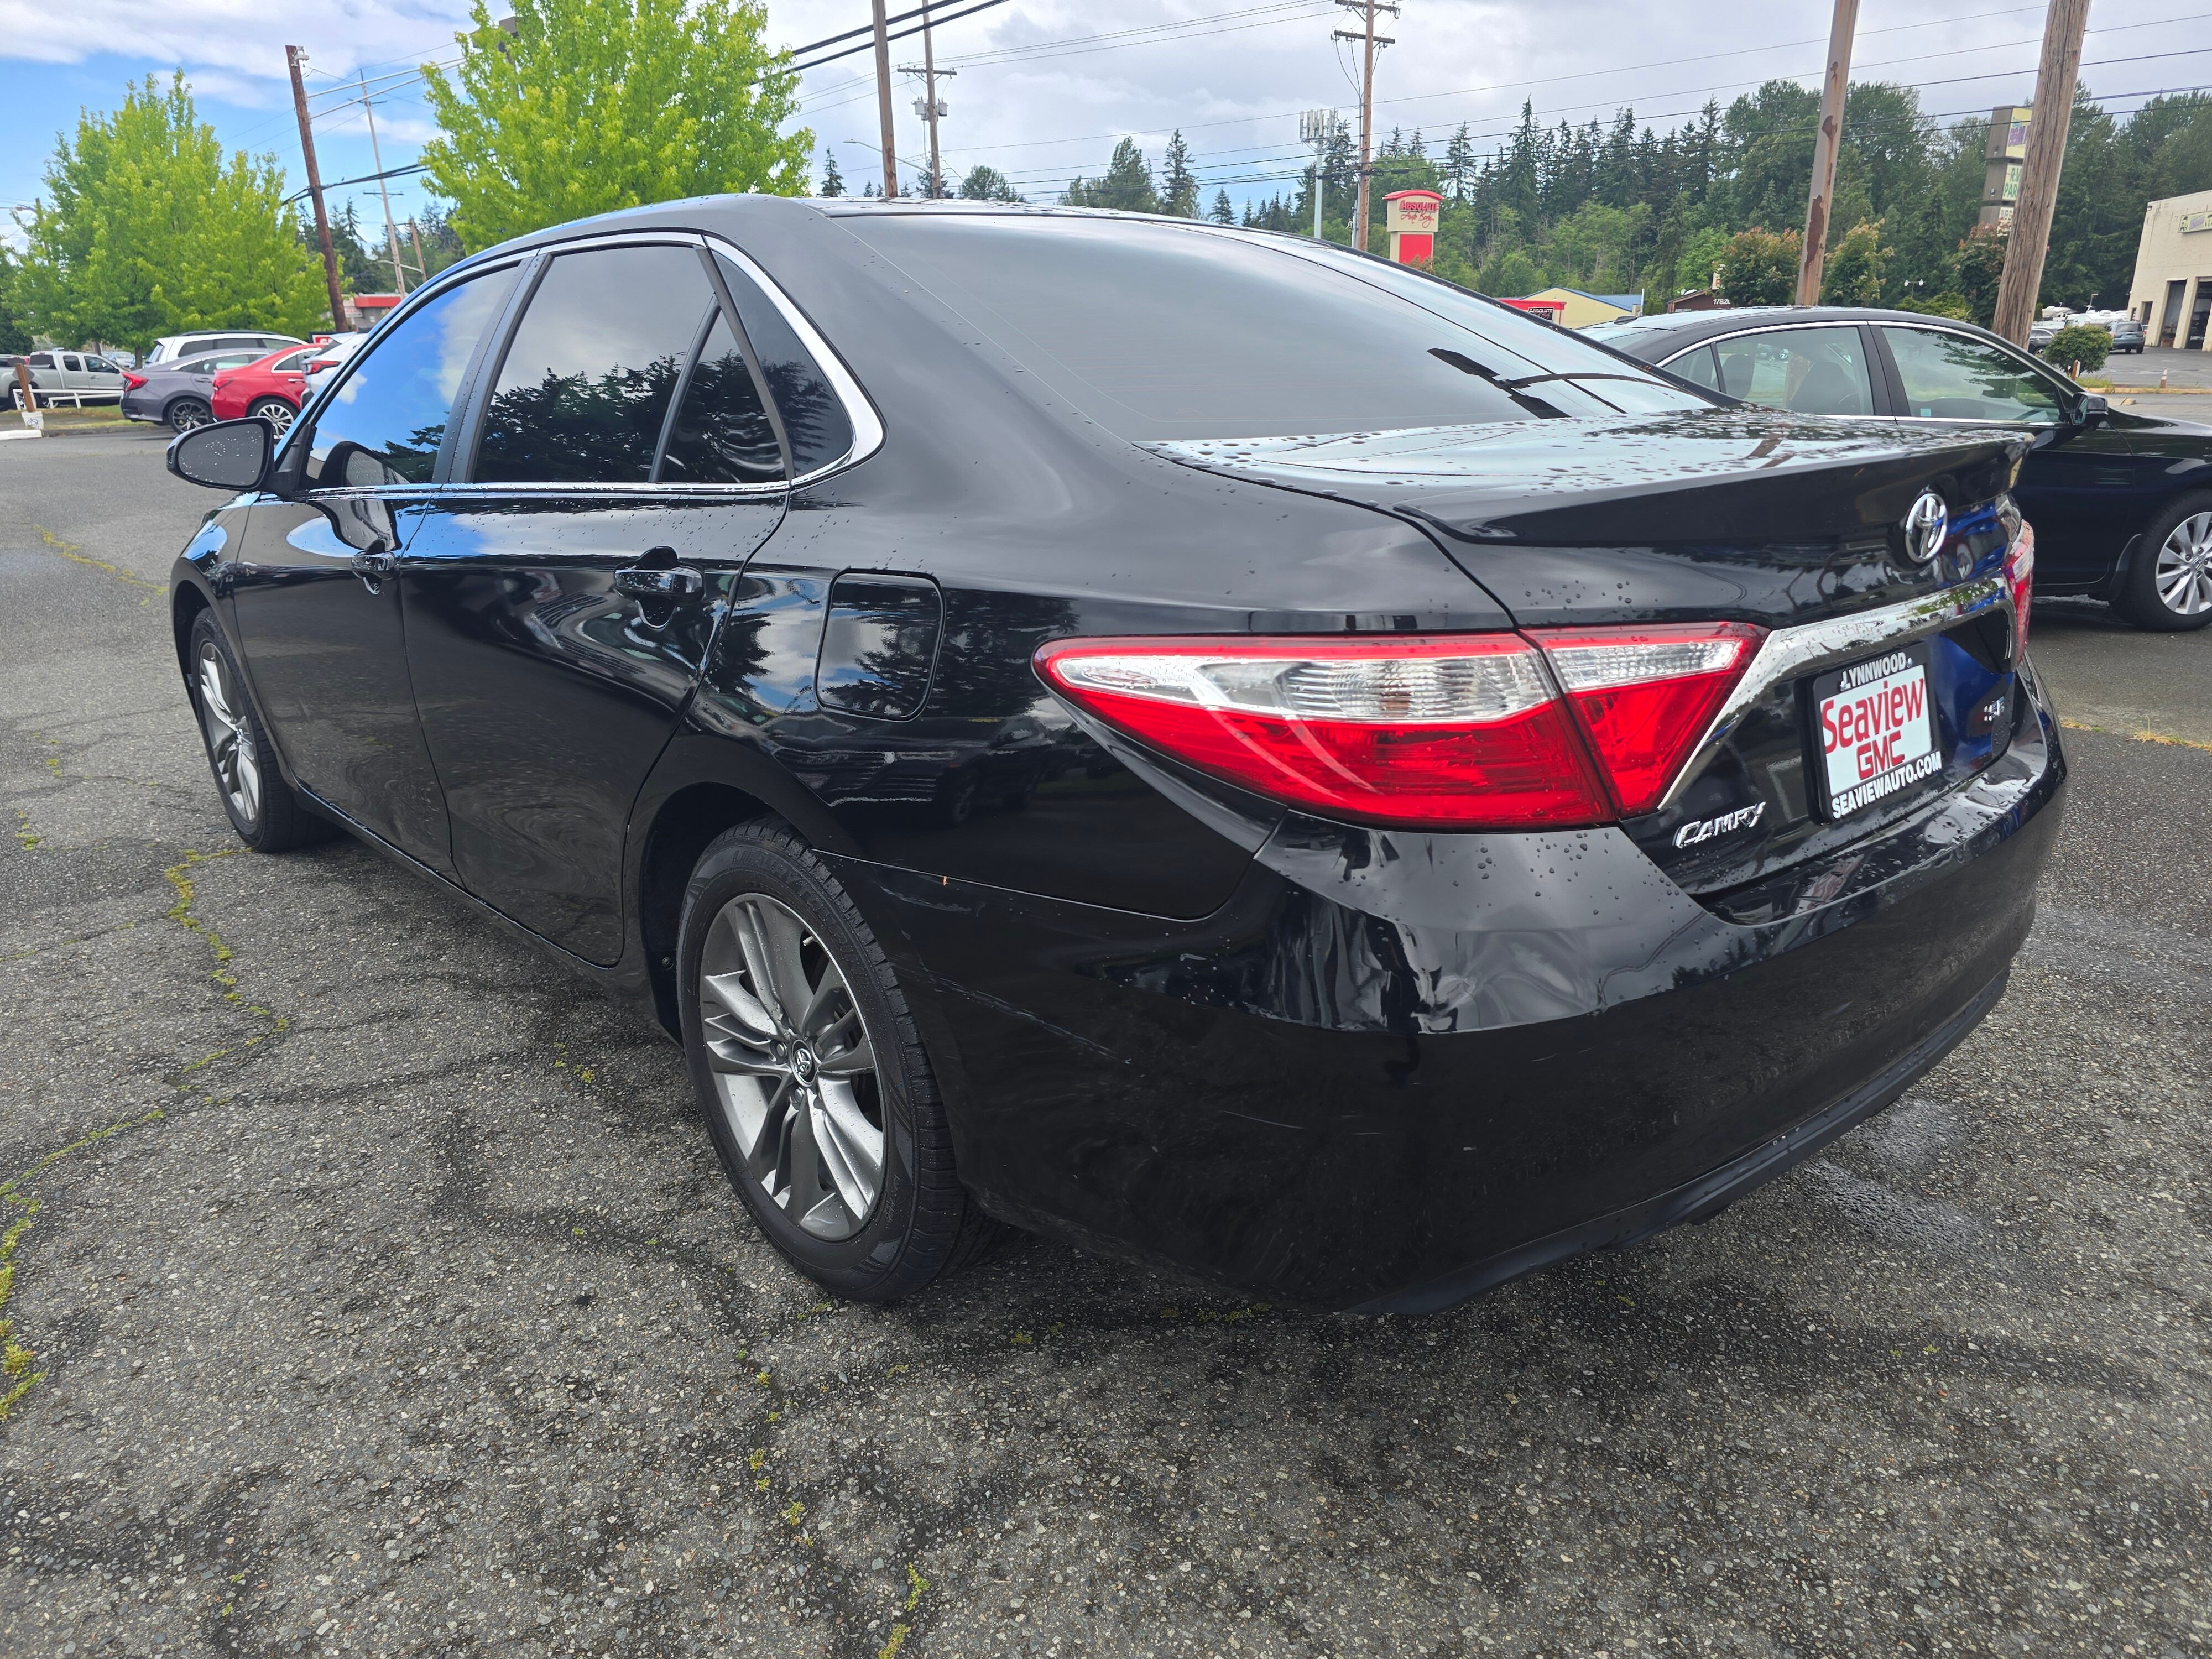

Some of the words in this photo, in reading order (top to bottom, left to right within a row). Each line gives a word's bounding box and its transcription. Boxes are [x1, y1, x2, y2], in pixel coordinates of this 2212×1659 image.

[1399, 200, 1439, 211] ABSOLUTE
[2004, 183, 2018, 197] PAR
[1841, 651, 1906, 690] LYNNWOOD
[1822, 677, 1924, 754] Seaview
[1856, 730, 1905, 780] GMC
[1832, 751, 1942, 819] SEAVIEWAUTO.COM
[1673, 801, 1766, 849] CAMRY
